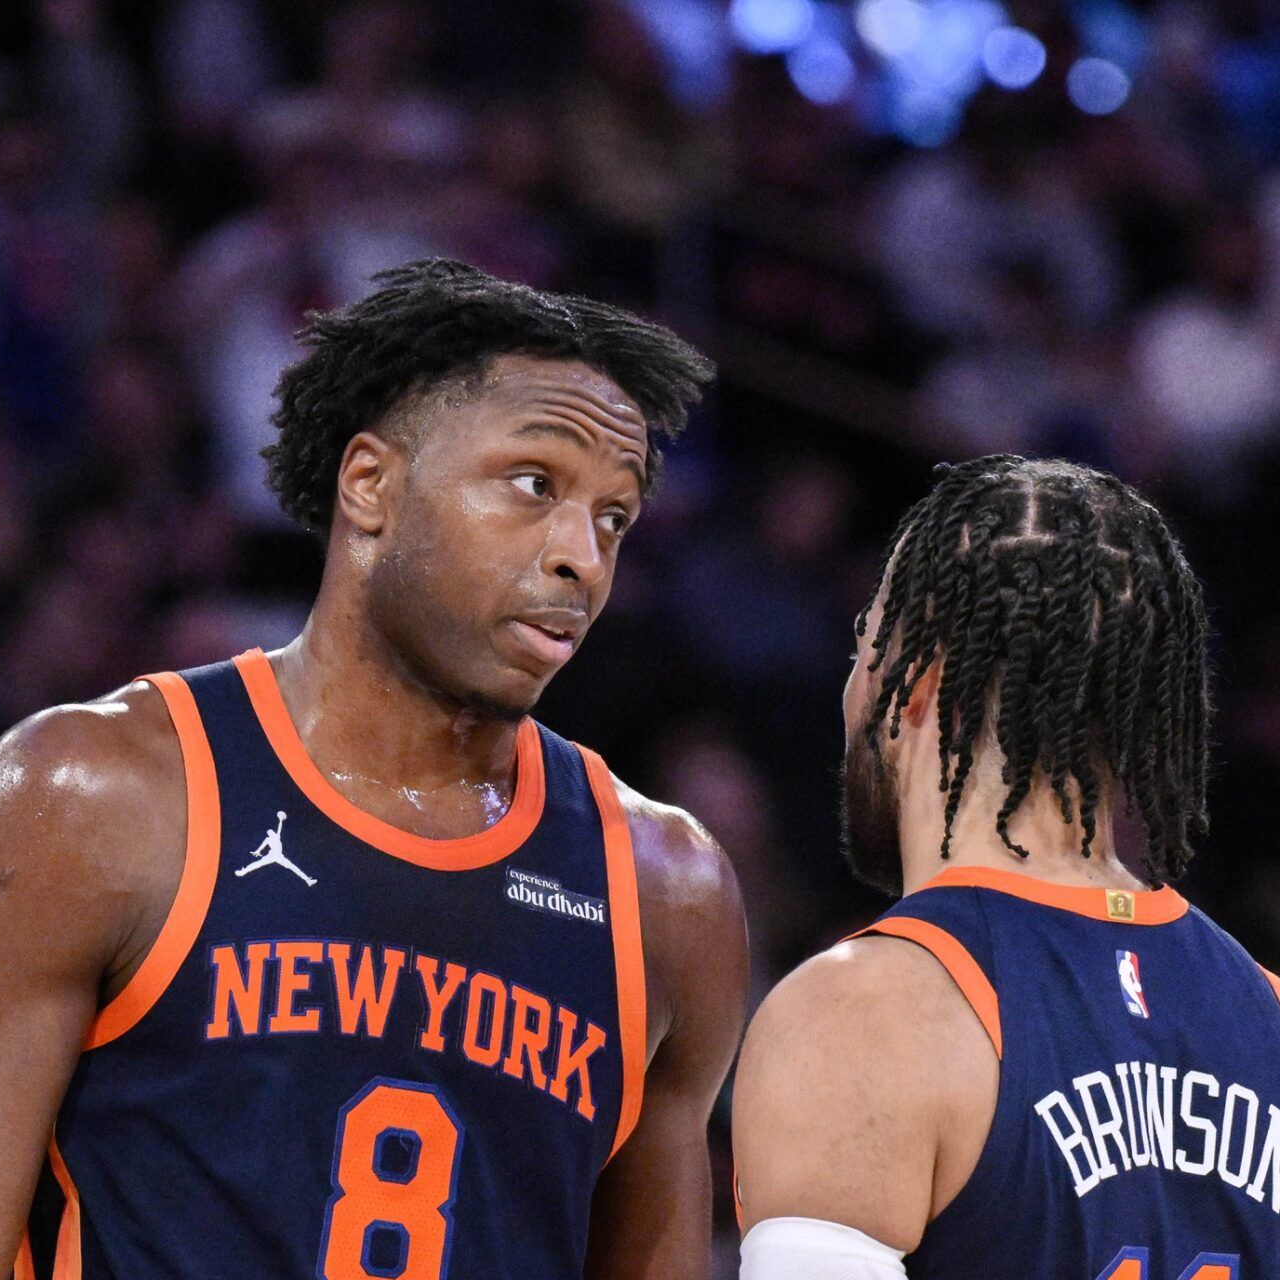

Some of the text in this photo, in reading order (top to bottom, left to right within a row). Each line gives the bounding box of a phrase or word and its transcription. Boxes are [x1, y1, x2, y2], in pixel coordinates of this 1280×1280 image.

[510, 869, 560, 891] experience
[507, 883, 604, 923] abu dhabi
[205, 940, 607, 1121] NEW YORK
